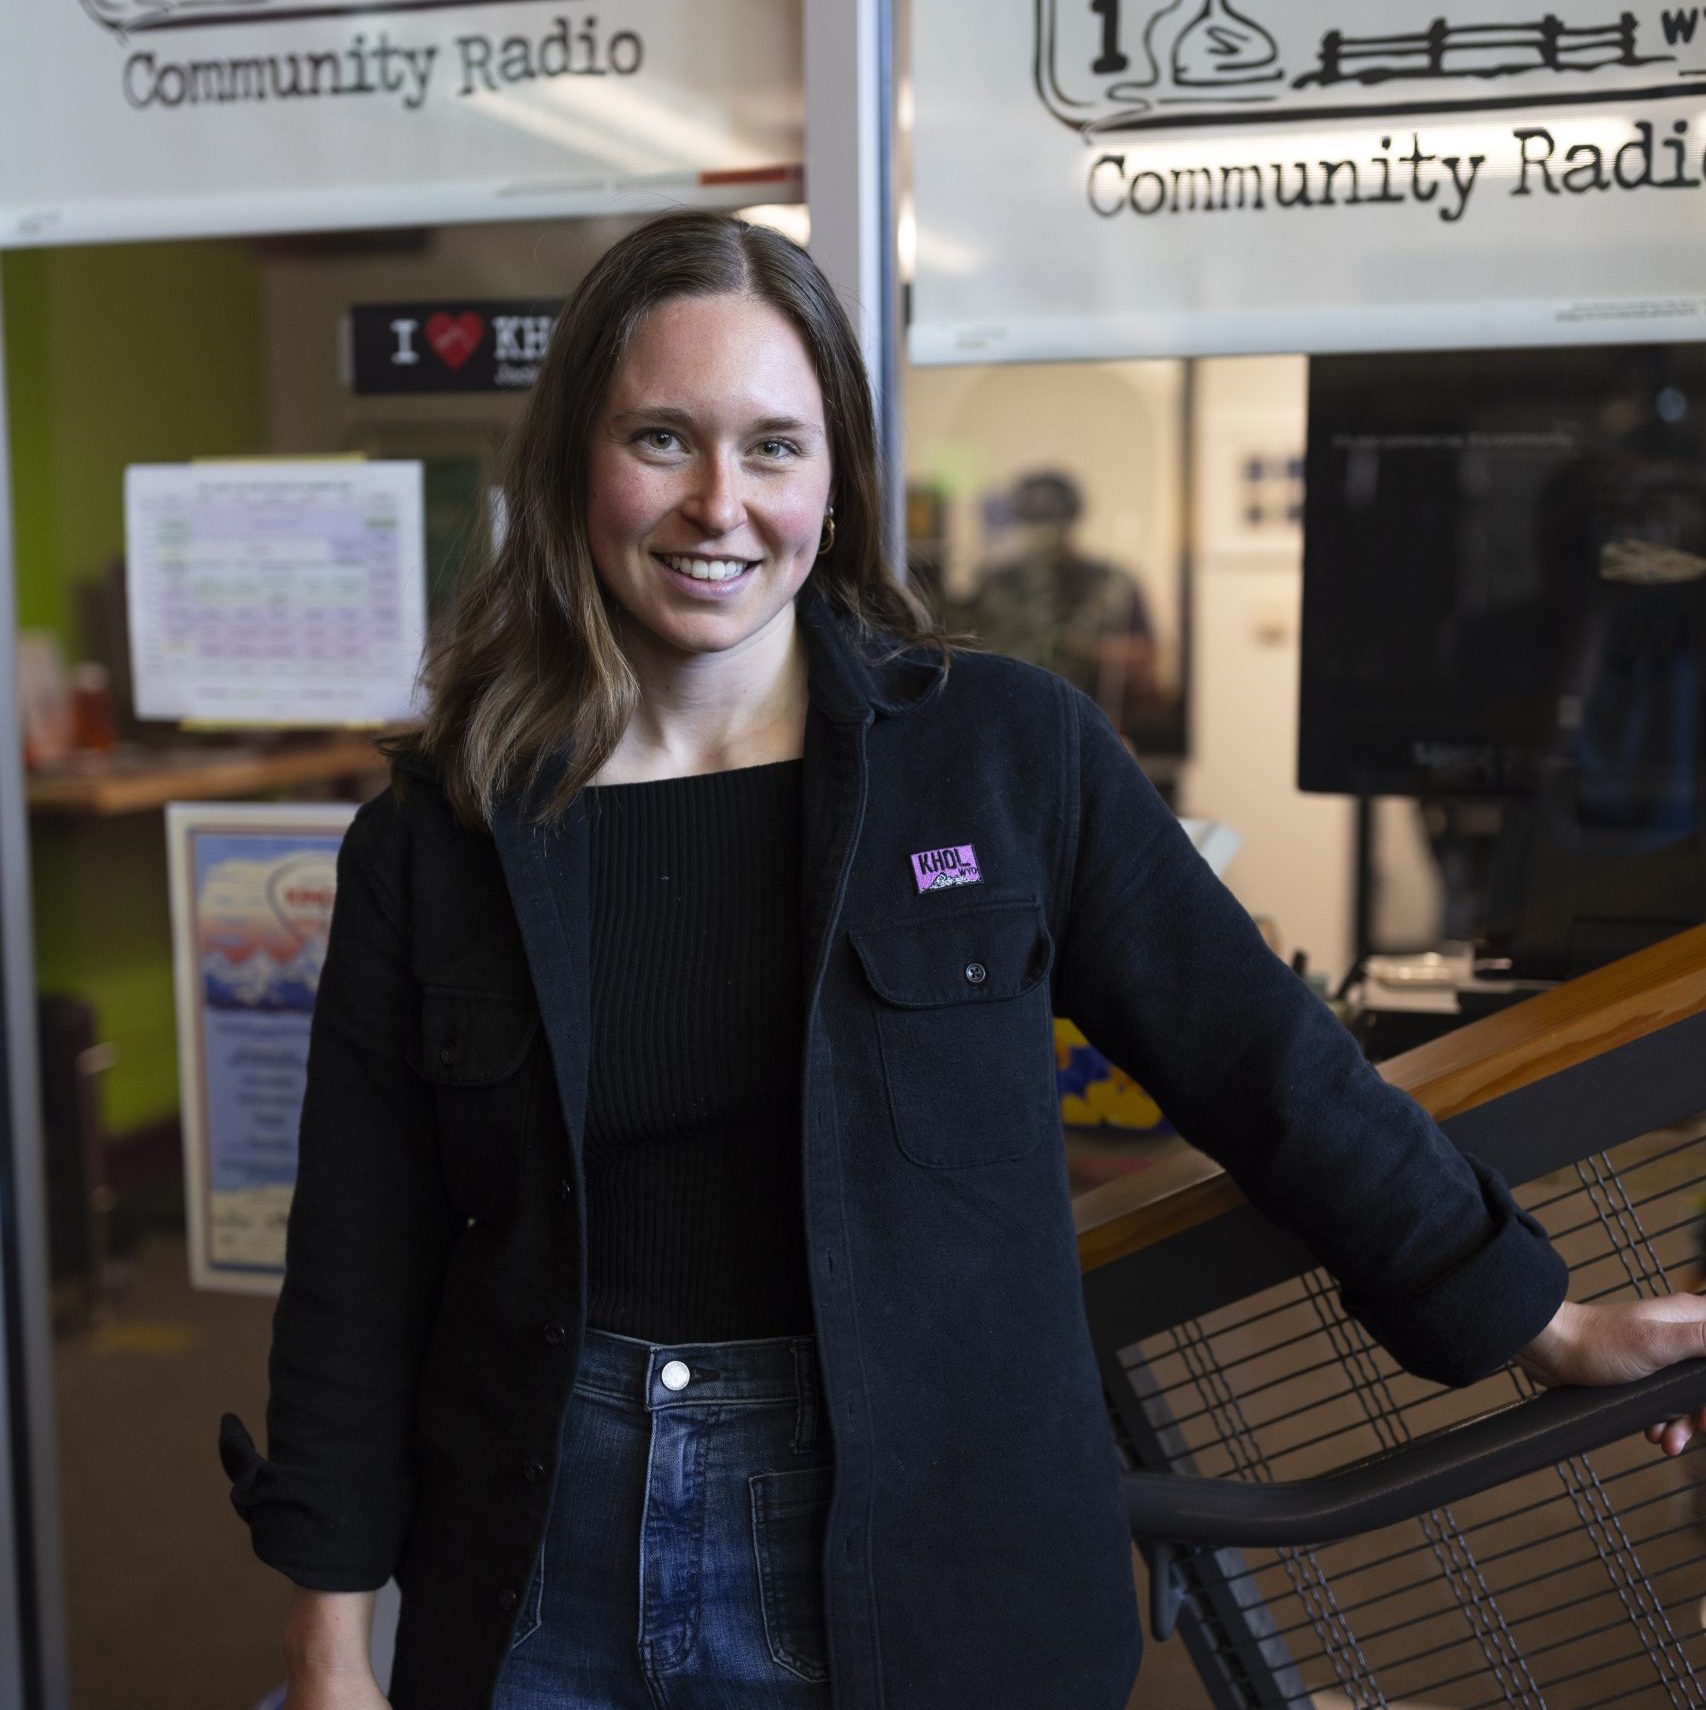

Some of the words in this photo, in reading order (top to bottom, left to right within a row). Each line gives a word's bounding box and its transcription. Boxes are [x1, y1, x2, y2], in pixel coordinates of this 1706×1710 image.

[1661, 7, 1706, 46] W
[123, 31, 439, 109] Community
[456, 15, 644, 98] Radio
[1087, 134, 1485, 222] Community
[1511, 119, 1706, 196] Radi
[390, 318, 419, 367] I
[492, 315, 558, 362] KH
[918, 848, 972, 876] KHOL
